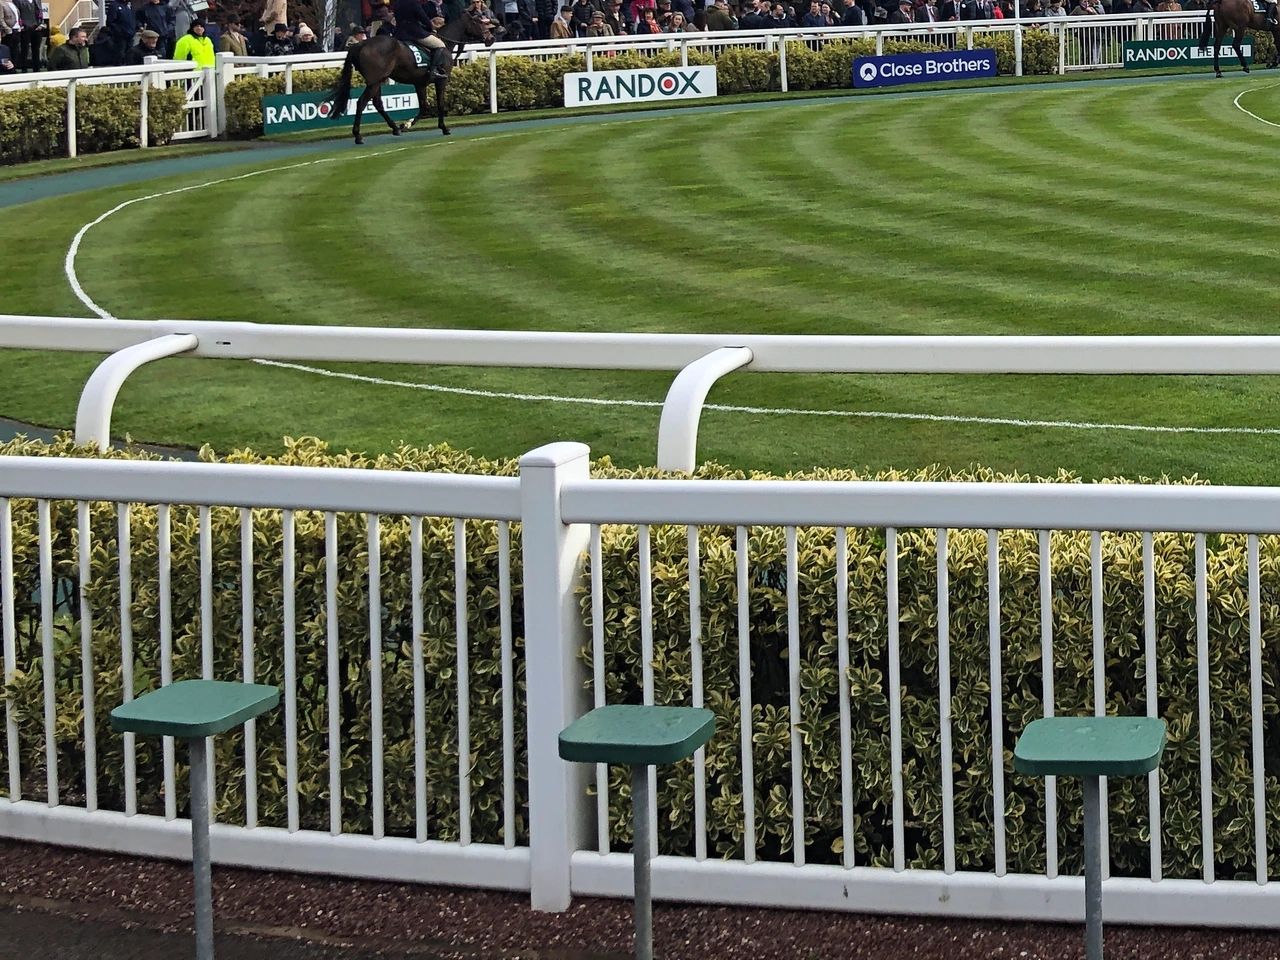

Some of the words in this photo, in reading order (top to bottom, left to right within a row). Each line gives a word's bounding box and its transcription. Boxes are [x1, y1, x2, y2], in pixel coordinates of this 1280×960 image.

[1253, 1, 1260, 10] 5
[413, 51, 422, 64] 6
[1126, 46, 1188, 62] RANDOX
[880, 60, 922, 78] Close
[926, 56, 991, 75] Brothers
[577, 69, 702, 103] RANDOX
[266, 99, 344, 125] RANDO
